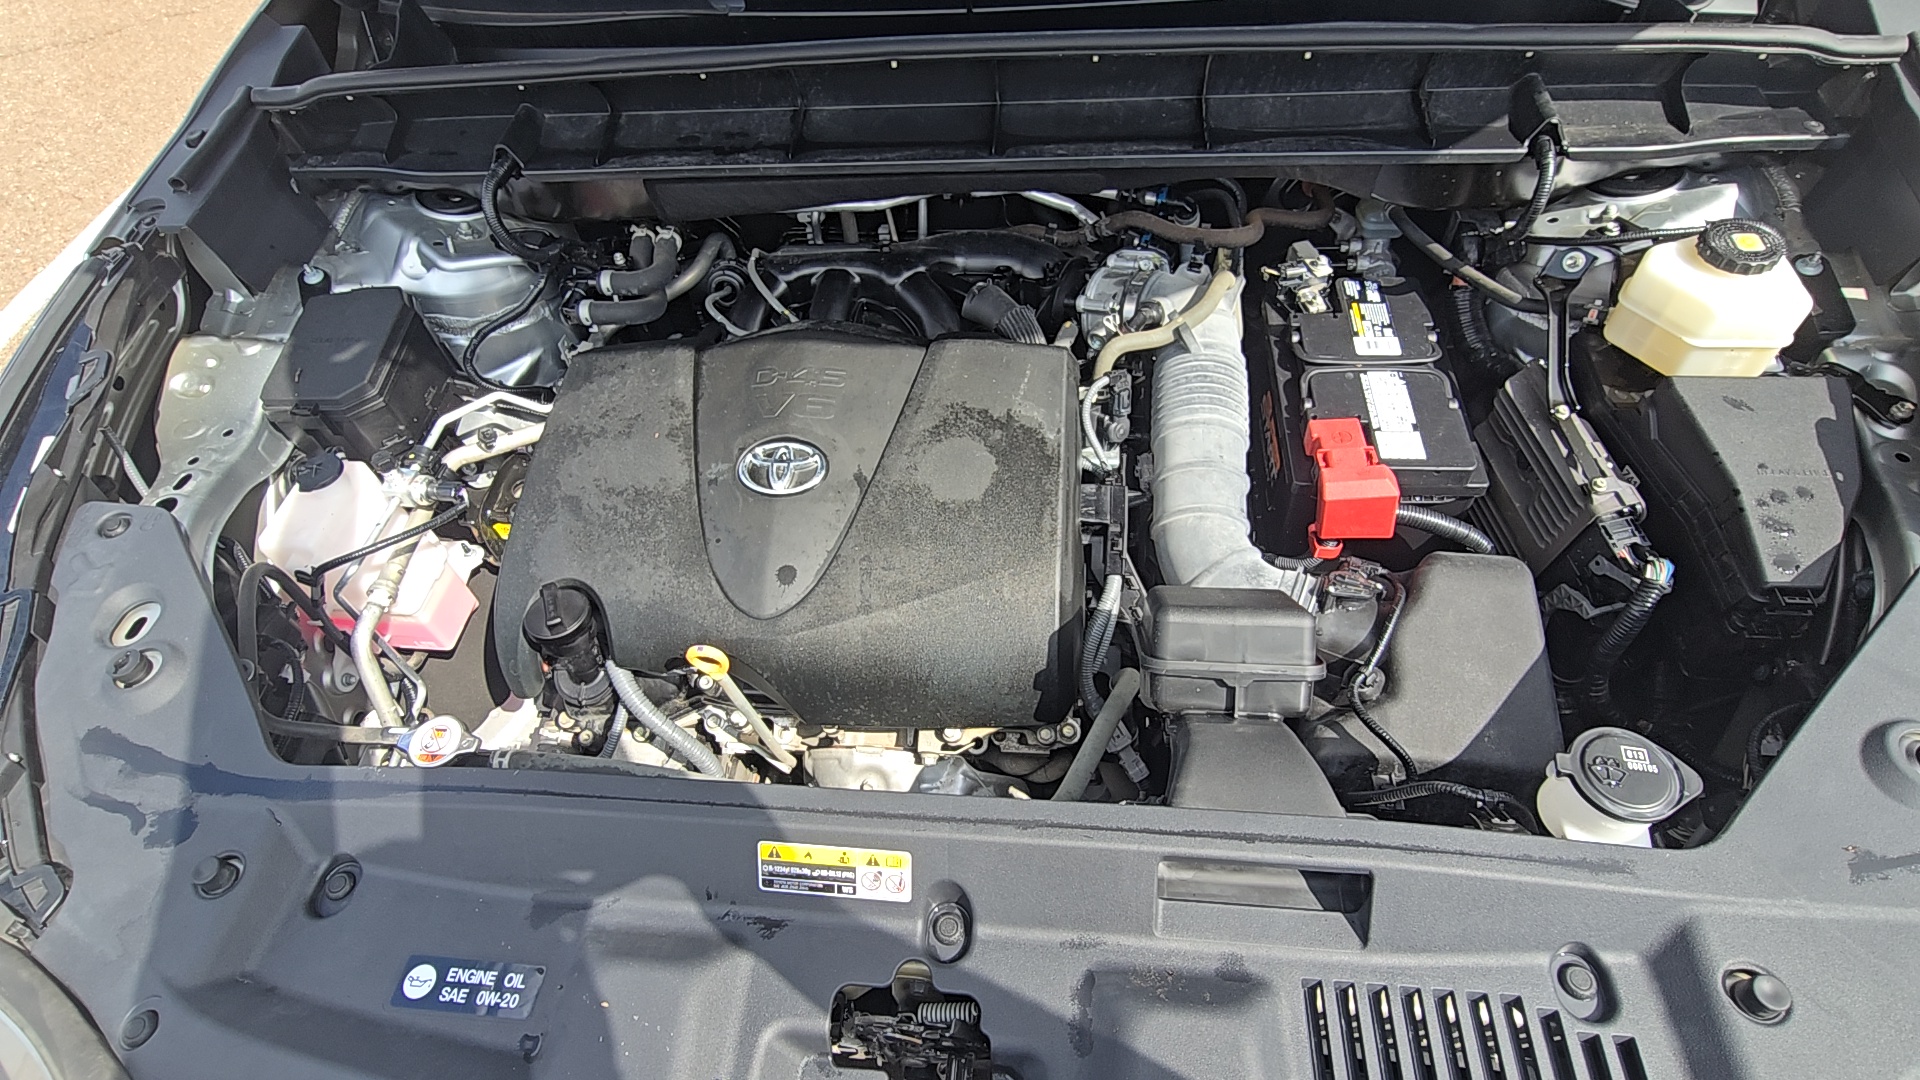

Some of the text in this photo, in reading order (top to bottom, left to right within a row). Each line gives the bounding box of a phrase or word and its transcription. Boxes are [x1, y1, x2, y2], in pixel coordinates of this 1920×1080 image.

[755, 392, 836, 420] V6
[445, 967, 526, 989] ENGINE OIL
[438, 986, 520, 1009] SAE 0W-20
